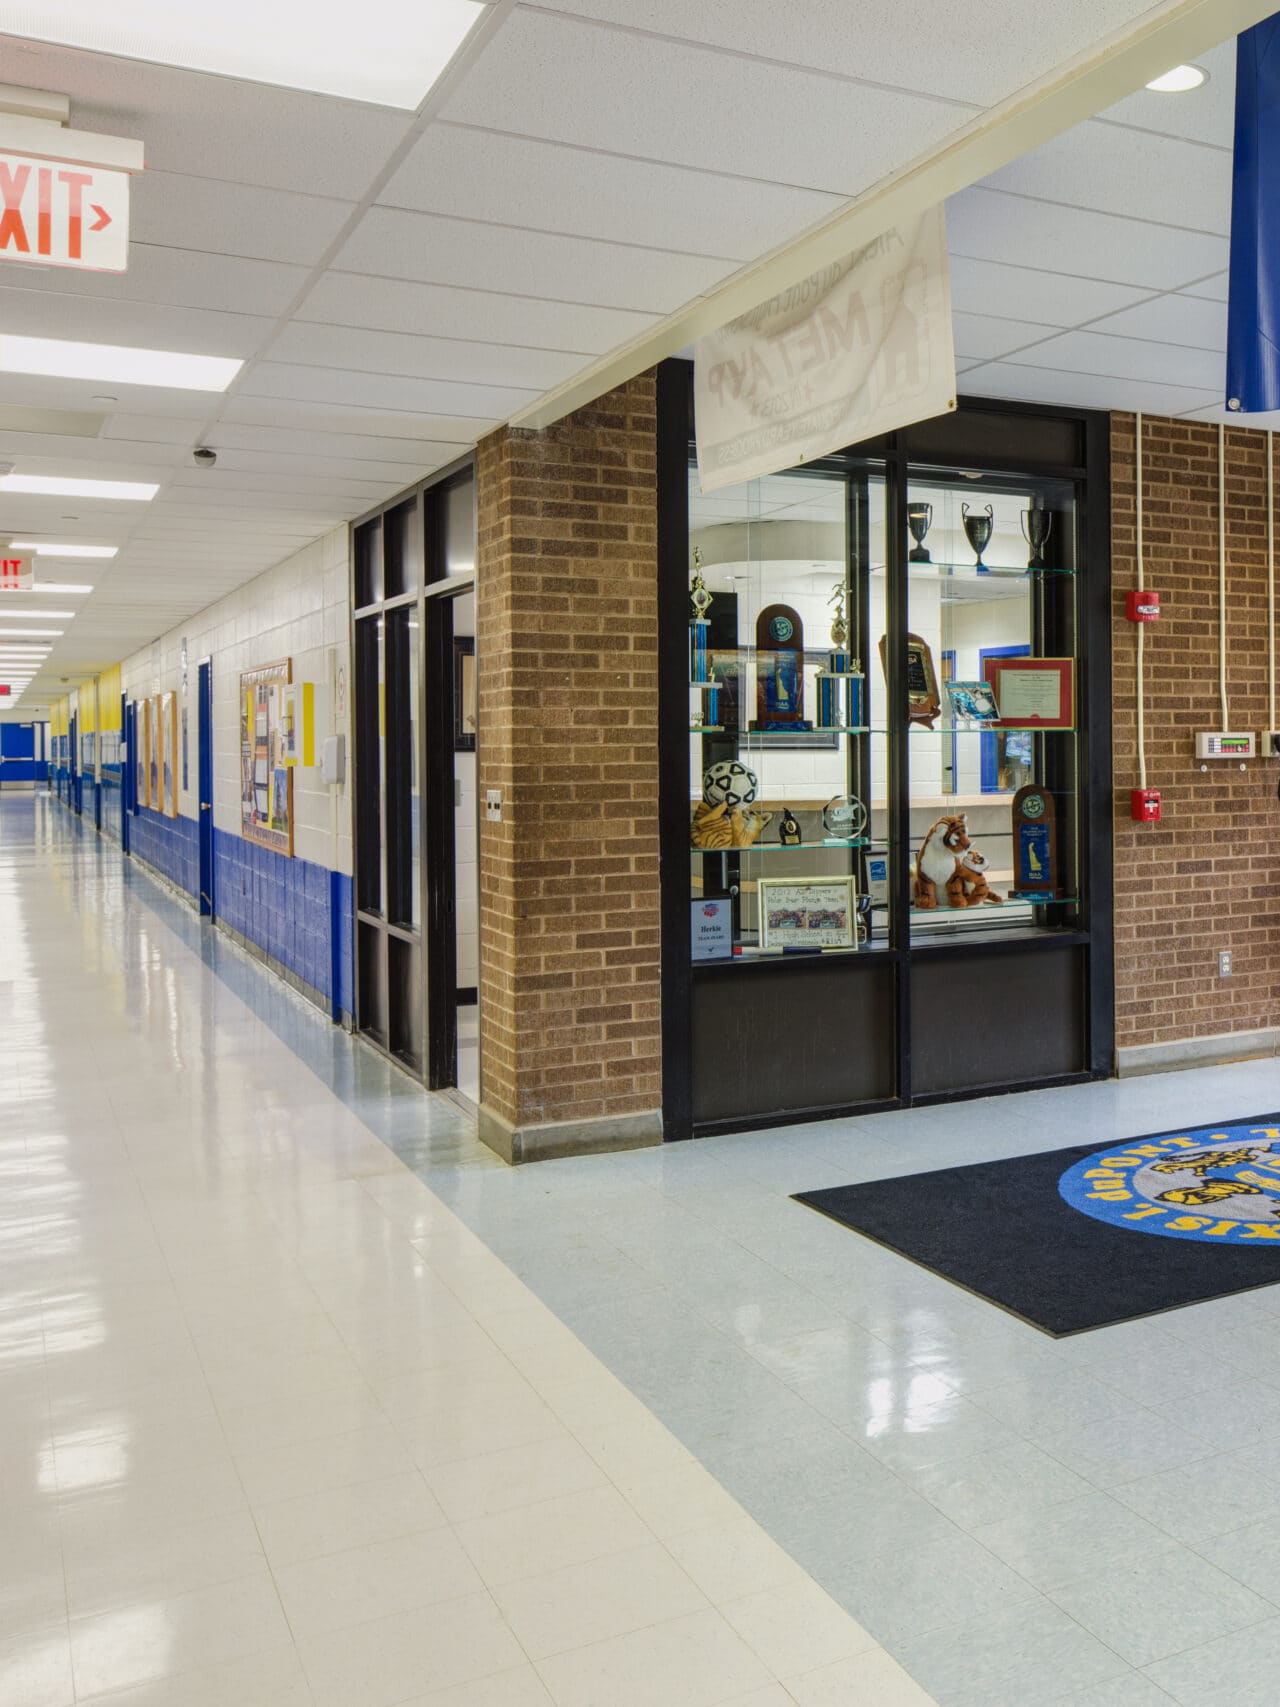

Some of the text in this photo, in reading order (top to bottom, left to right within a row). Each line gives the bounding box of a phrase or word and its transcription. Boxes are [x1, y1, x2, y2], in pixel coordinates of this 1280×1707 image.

[0, 162, 93, 259] XIT
[0, 560, 22, 588] IT
[1083, 1136, 1190, 1201] duPONT
[1121, 1202, 1153, 1221] I.
